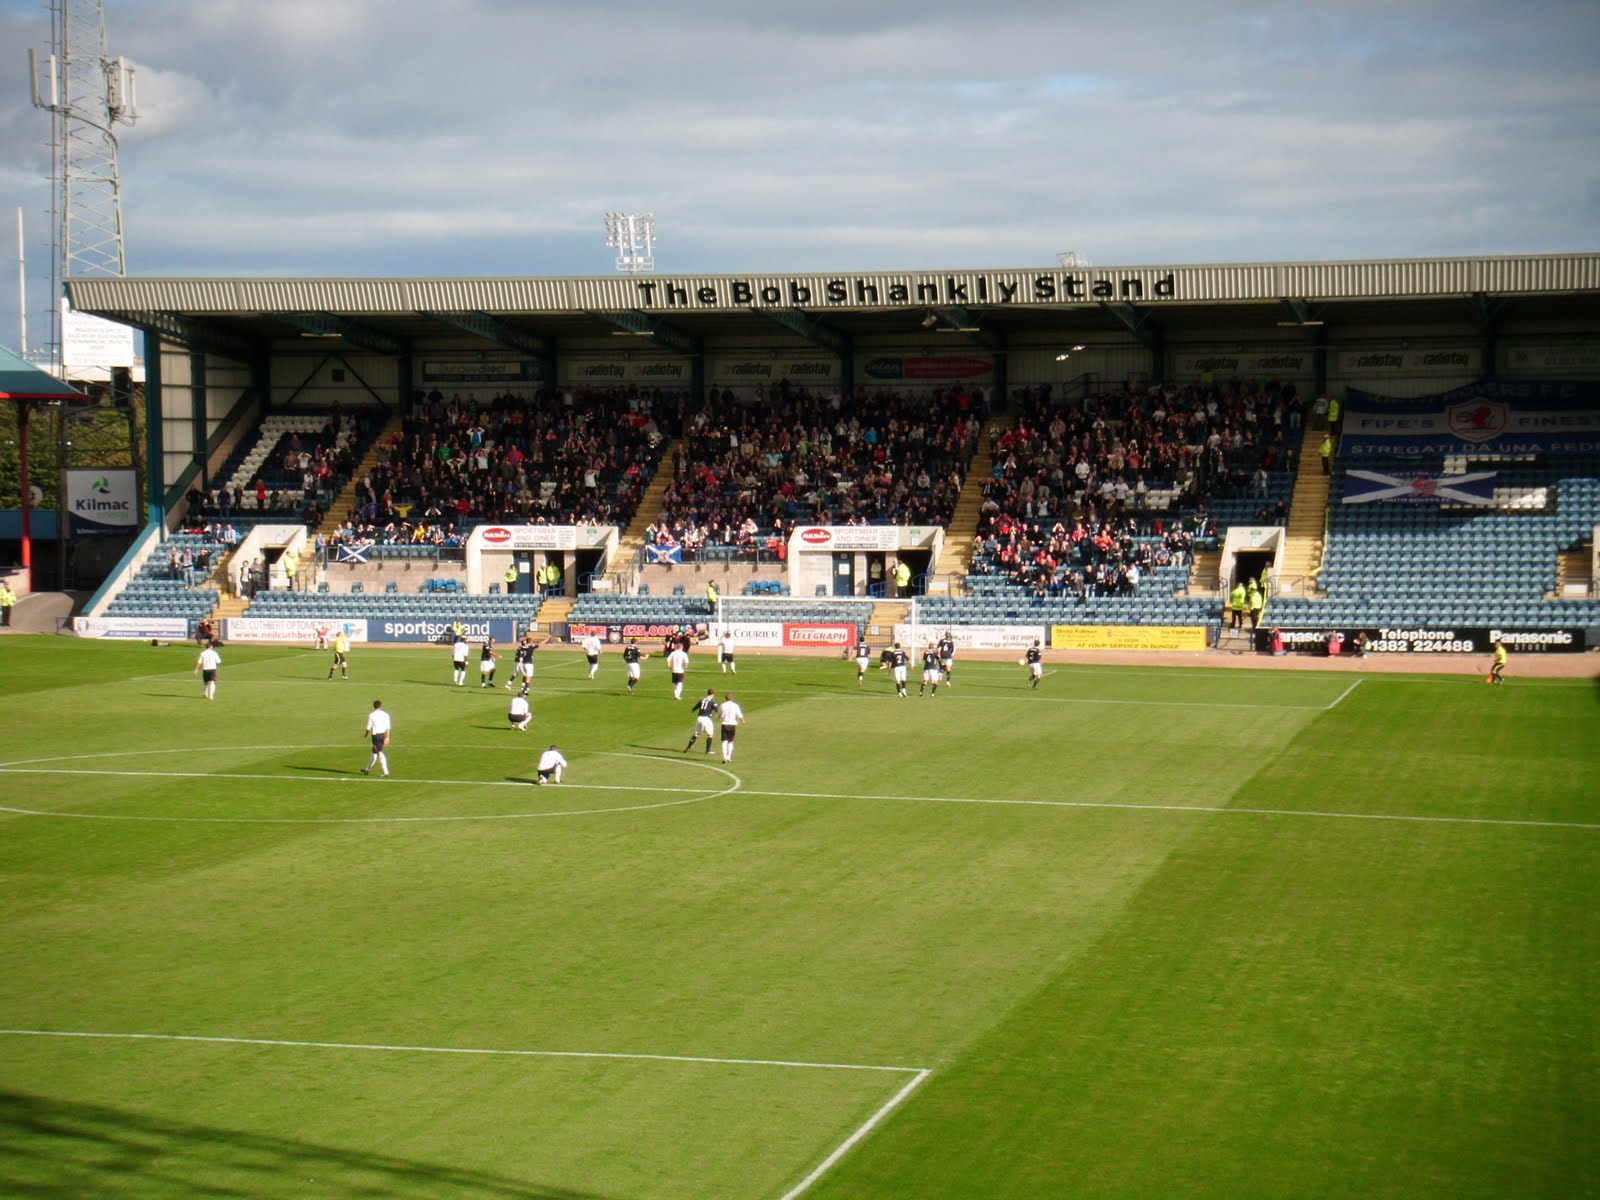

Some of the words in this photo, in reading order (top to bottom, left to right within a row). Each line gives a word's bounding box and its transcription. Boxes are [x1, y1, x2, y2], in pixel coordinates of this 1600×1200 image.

[639, 283, 718, 305] The
[733, 280, 811, 304] Bob
[828, 277, 1019, 303] Shankly
[1036, 274, 1175, 299] Stand
[1361, 418, 1434, 429] FIFE'S
[1351, 444, 1454, 455] STREGATI
[1462, 443, 1490, 453] DA
[1499, 443, 1543, 453] UNA
[76, 499, 128, 510] Kilmac
[231, 620, 247, 629] NEIL
[249, 620, 286, 630] CUTHBERT
[384, 621, 490, 637] sportscoand
[734, 628, 778, 639] COURIER
[791, 629, 846, 640] TELEGRAPH
[1379, 629, 1455, 642] Telephone
[1489, 629, 1572, 644] Panasonic
[943, 643, 949, 652] 6
[1372, 640, 1408, 652] 1382
[1413, 640, 1474, 652] 224488
[897, 655, 902, 663] 2
[701, 699, 709, 710] 11
